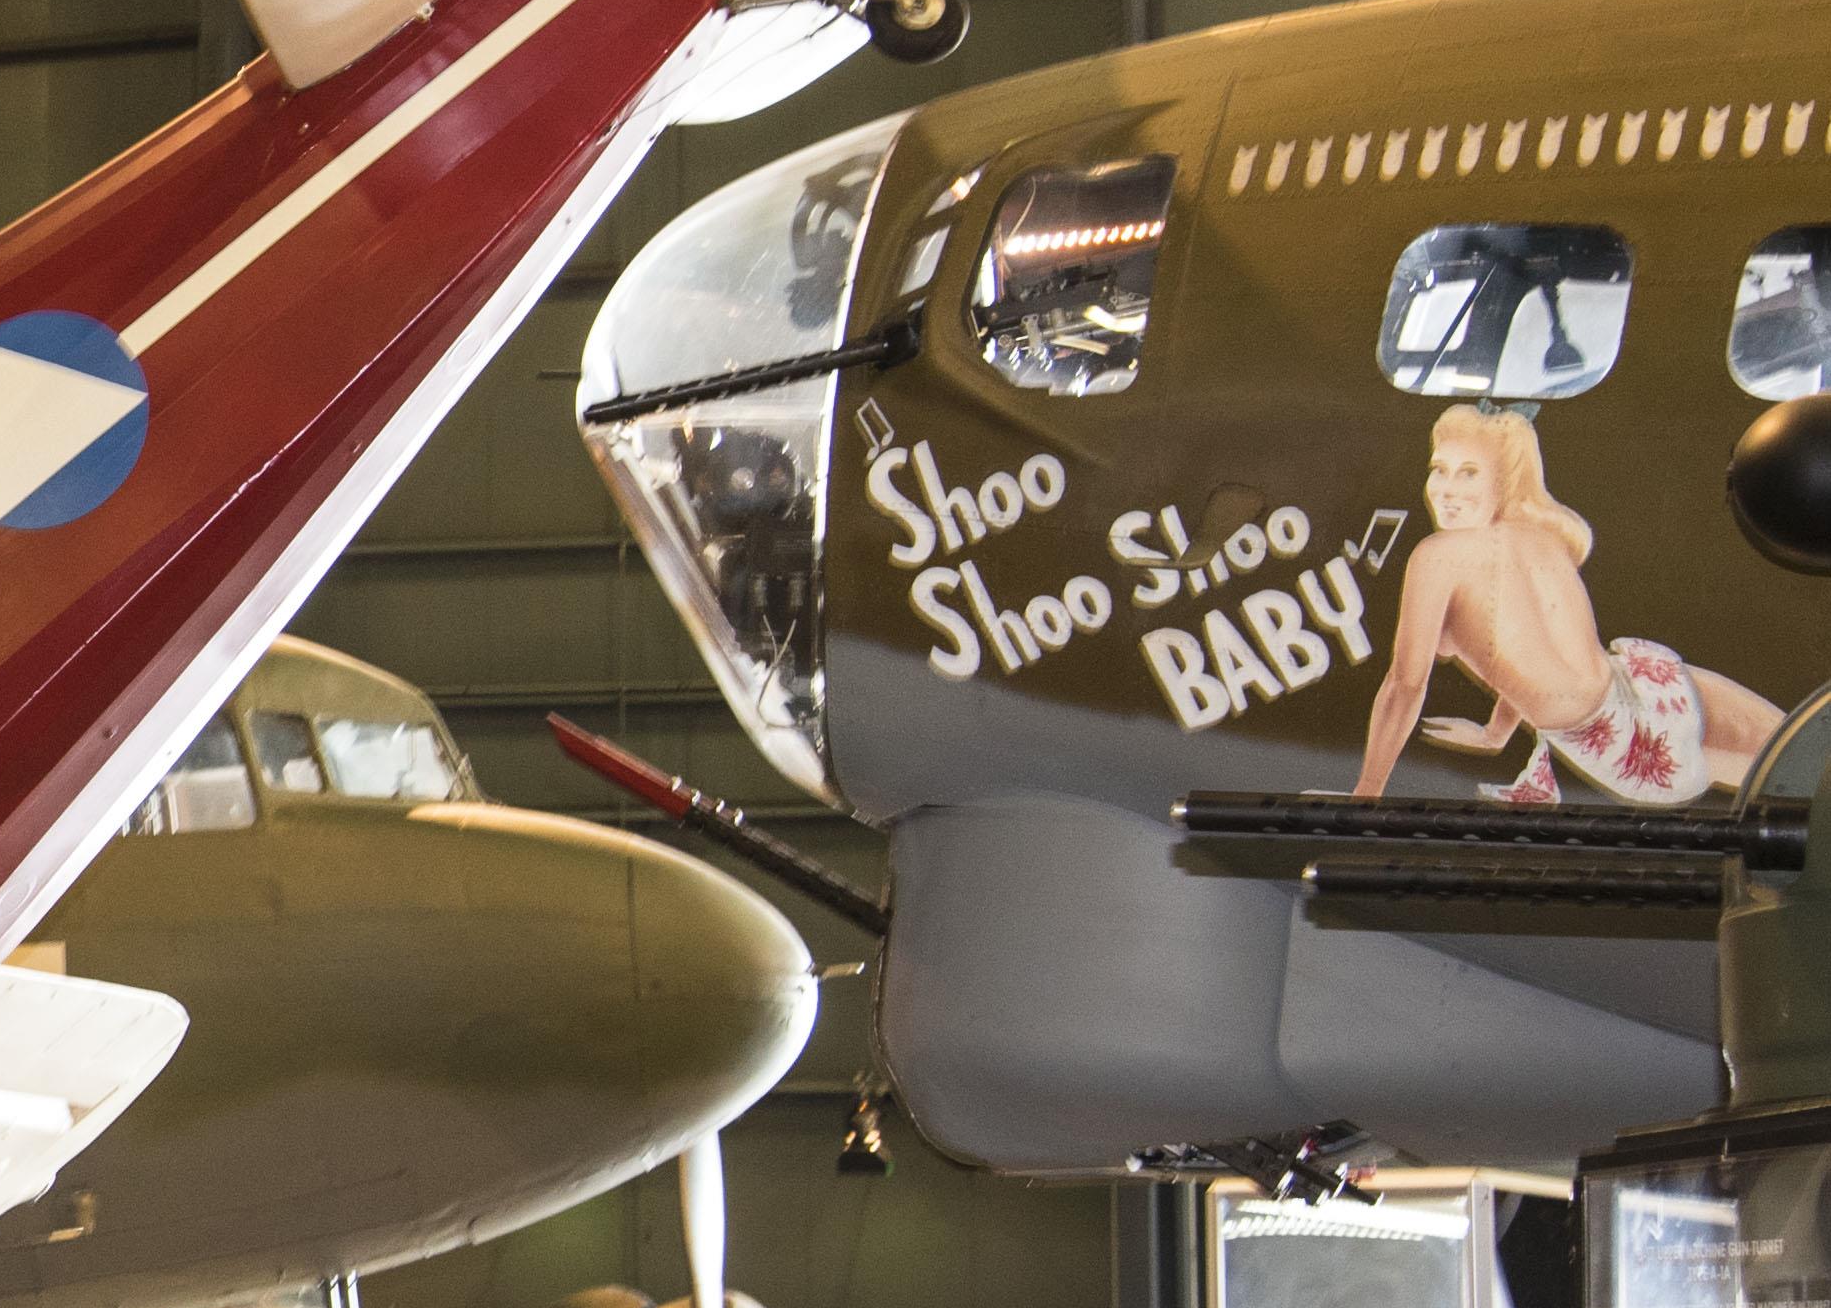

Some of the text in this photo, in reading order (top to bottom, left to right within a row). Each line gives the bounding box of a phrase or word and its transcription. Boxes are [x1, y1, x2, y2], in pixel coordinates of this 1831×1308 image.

[867, 440, 1065, 569] Shoo
[909, 560, 1112, 679] Shoo
[1141, 556, 1373, 733] BABY
[1752, 1239, 1784, 1255] TURRET
